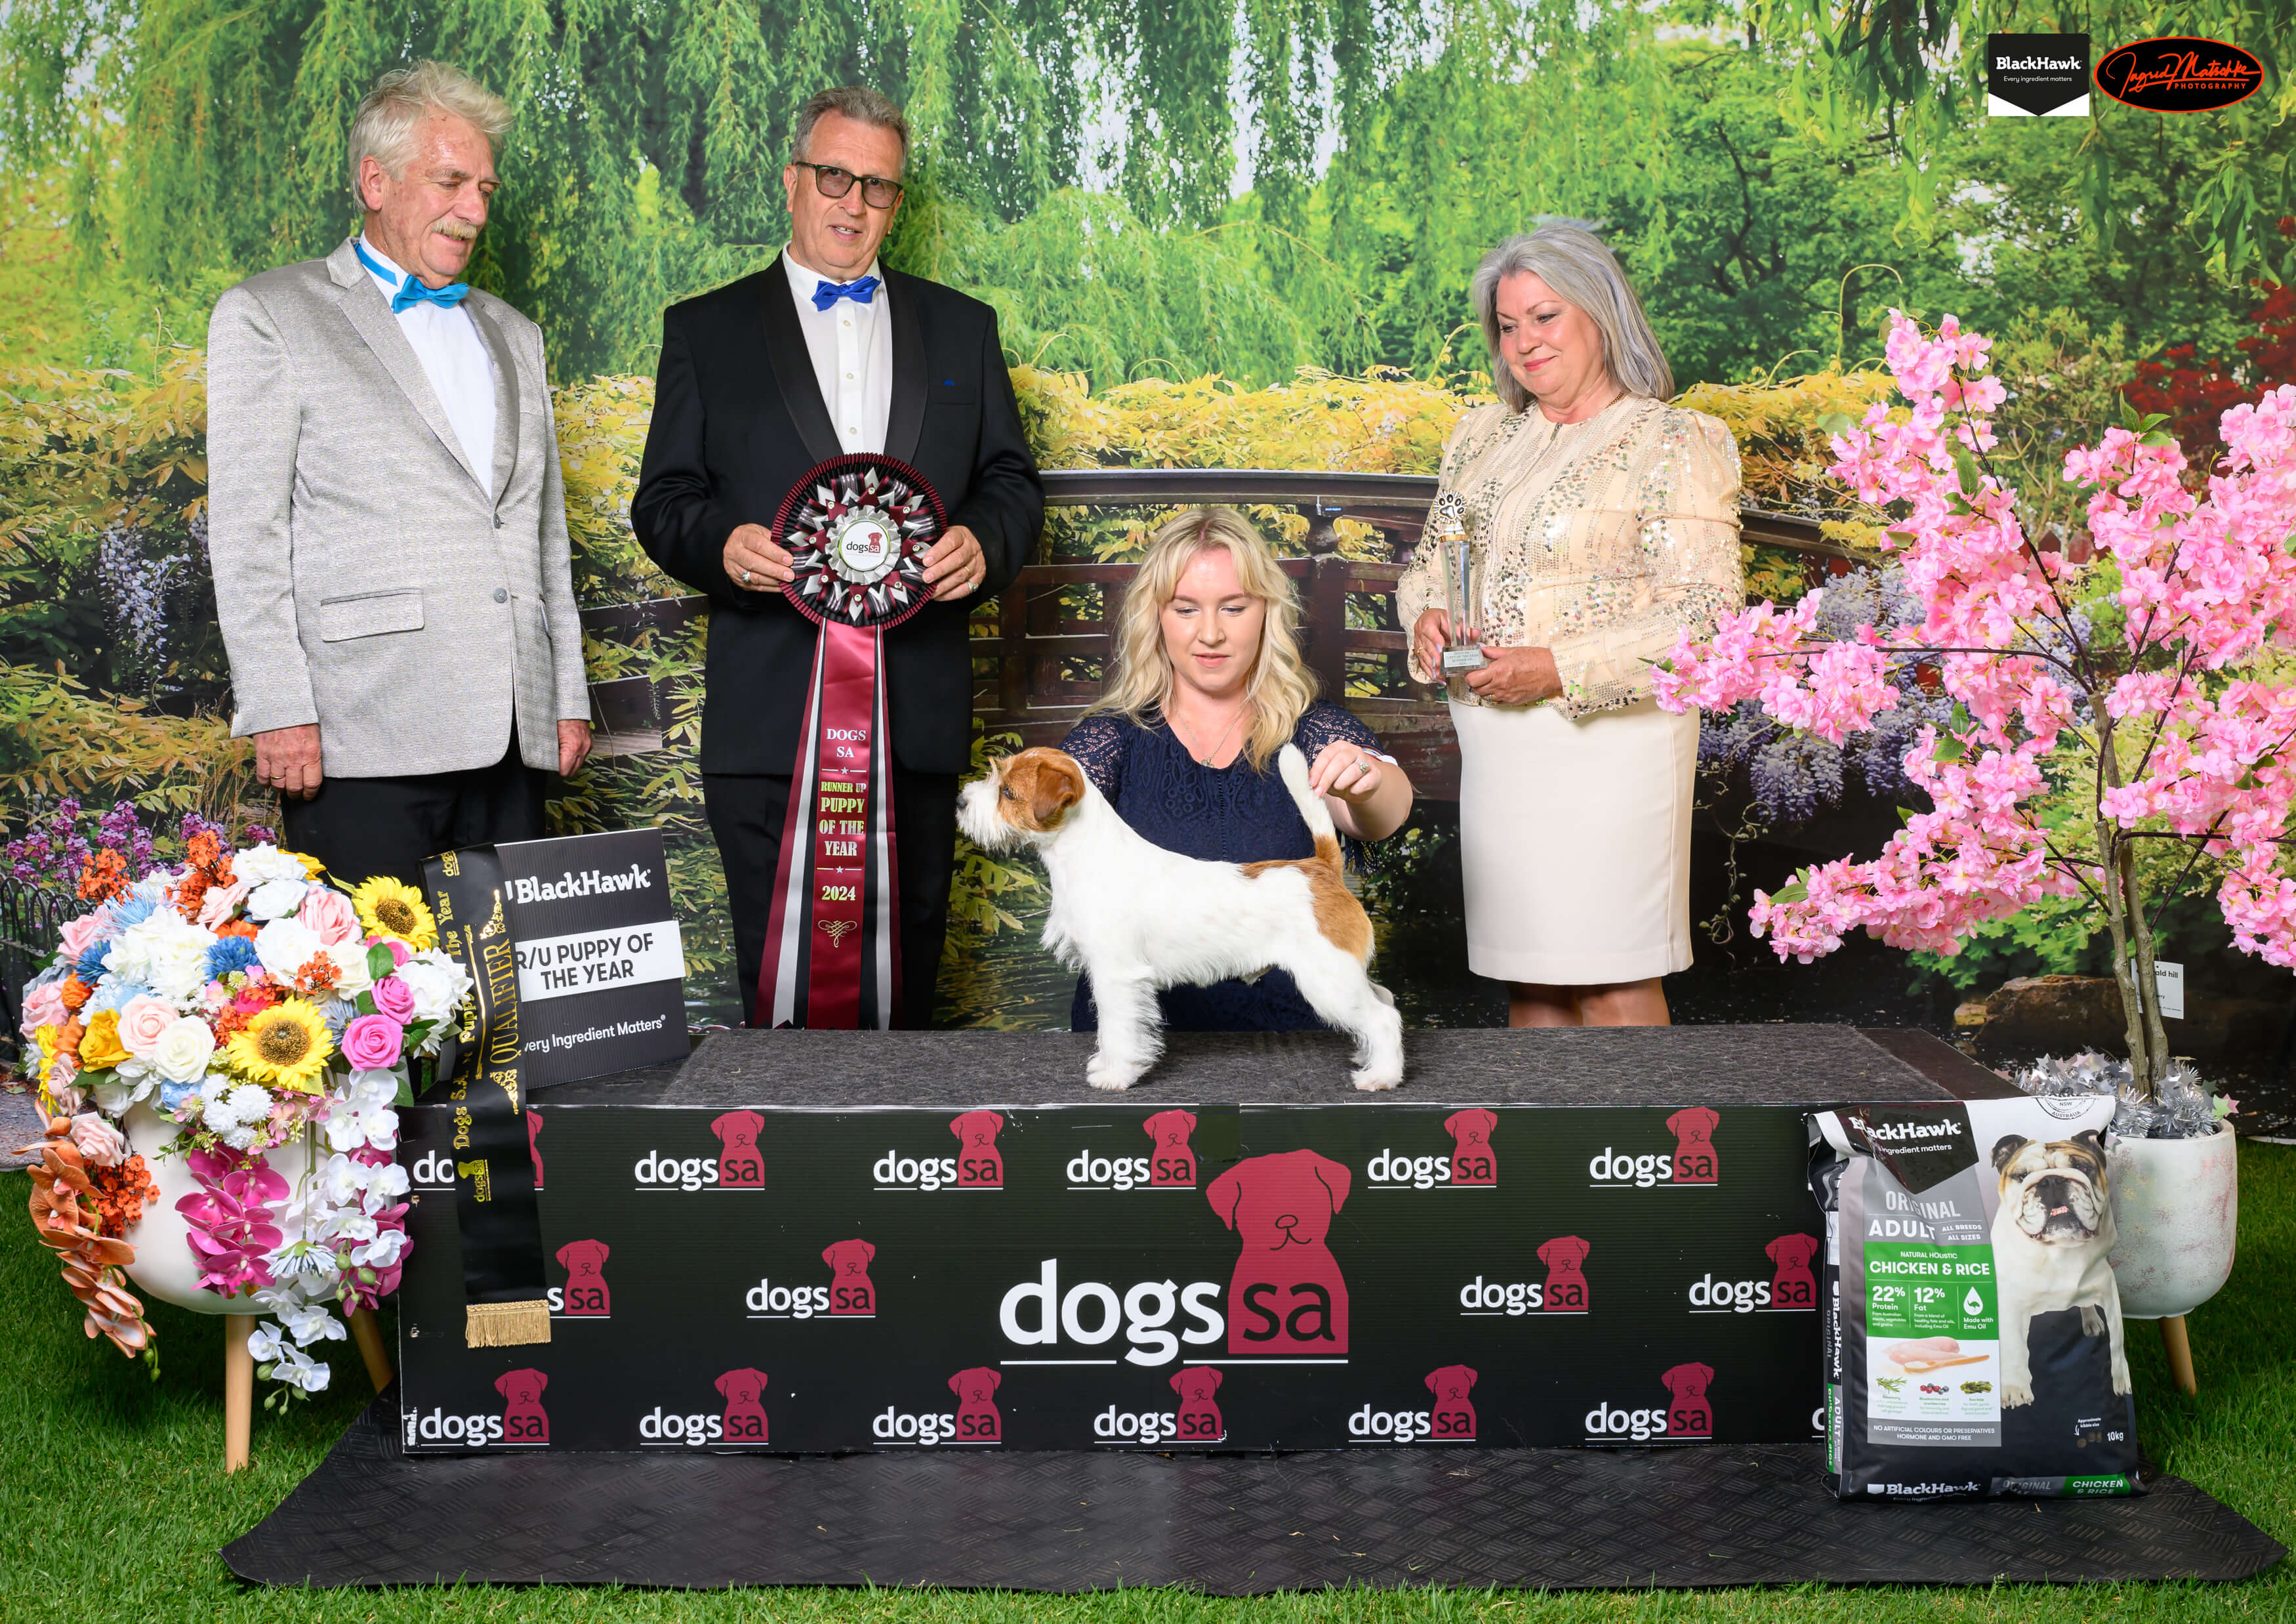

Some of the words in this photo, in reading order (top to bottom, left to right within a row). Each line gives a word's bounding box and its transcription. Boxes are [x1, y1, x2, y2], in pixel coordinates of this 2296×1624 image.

[826, 728, 867, 741] DOGS
[836, 746, 855, 758] SA
[821, 781, 853, 793] RUNNER
[855, 781, 867, 793] UP
[821, 797, 865, 813] PUPPY
[819, 819, 836, 835] OF
[839, 819, 865, 835] THE
[825, 841, 857, 856] YEAR
[515, 864, 651, 904] BlackHawk
[821, 886, 856, 901] 2024
[437, 890, 453, 925] Year
[514, 947, 551, 969] R/U
[557, 938, 621, 964] PUPPY
[627, 933, 654, 953] OF
[541, 967, 579, 989] THE
[582, 959, 634, 982] YEAR
[483, 938, 522, 1064] QUALIFIER
[525, 1039, 550, 1052] very
[552, 1025, 615, 1049] Ingredient
[453, 1106, 472, 1150] Dogs
[1921, 1144, 1952, 1152] matters
[1885, 1191, 1961, 1219] ORIGINAL
[1868, 1219, 1935, 1240] ADULT
[1870, 1260, 1938, 1274] CHICKEN
[1942, 1263, 1952, 1275] &
[1956, 1263, 1990, 1275] RICE
[1872, 1285, 1906, 1302] 22%
[1914, 1287, 1946, 1303] 12%
[2107, 1431, 2123, 1442] 10kg
[1886, 1481, 1979, 1495] BlackHawk
[2072, 1479, 2123, 1488] CHICKEN
